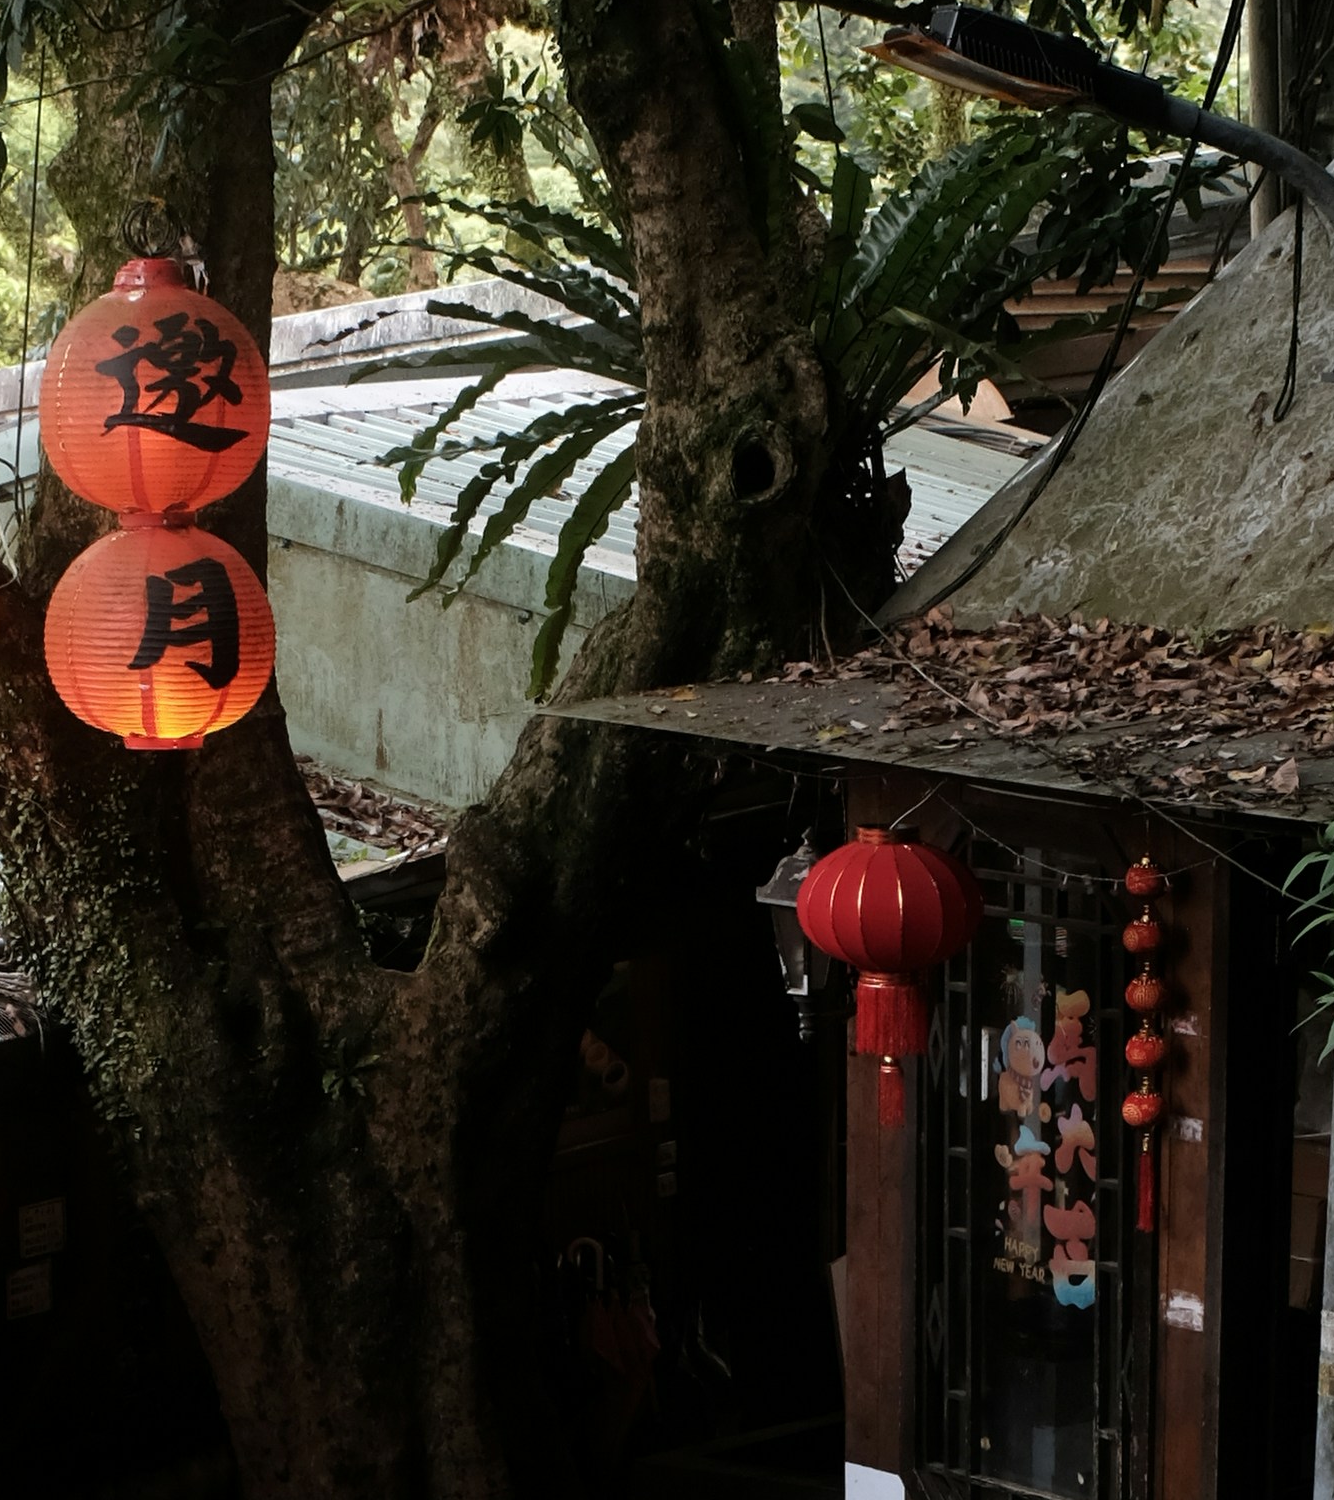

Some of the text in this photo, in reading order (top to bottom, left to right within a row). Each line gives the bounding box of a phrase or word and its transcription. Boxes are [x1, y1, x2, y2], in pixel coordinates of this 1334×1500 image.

[96, 312, 250, 691] 邀月
[1004, 1236, 1040, 1263] HAPPY
[993, 1257, 1047, 1284] NEW YEAR
